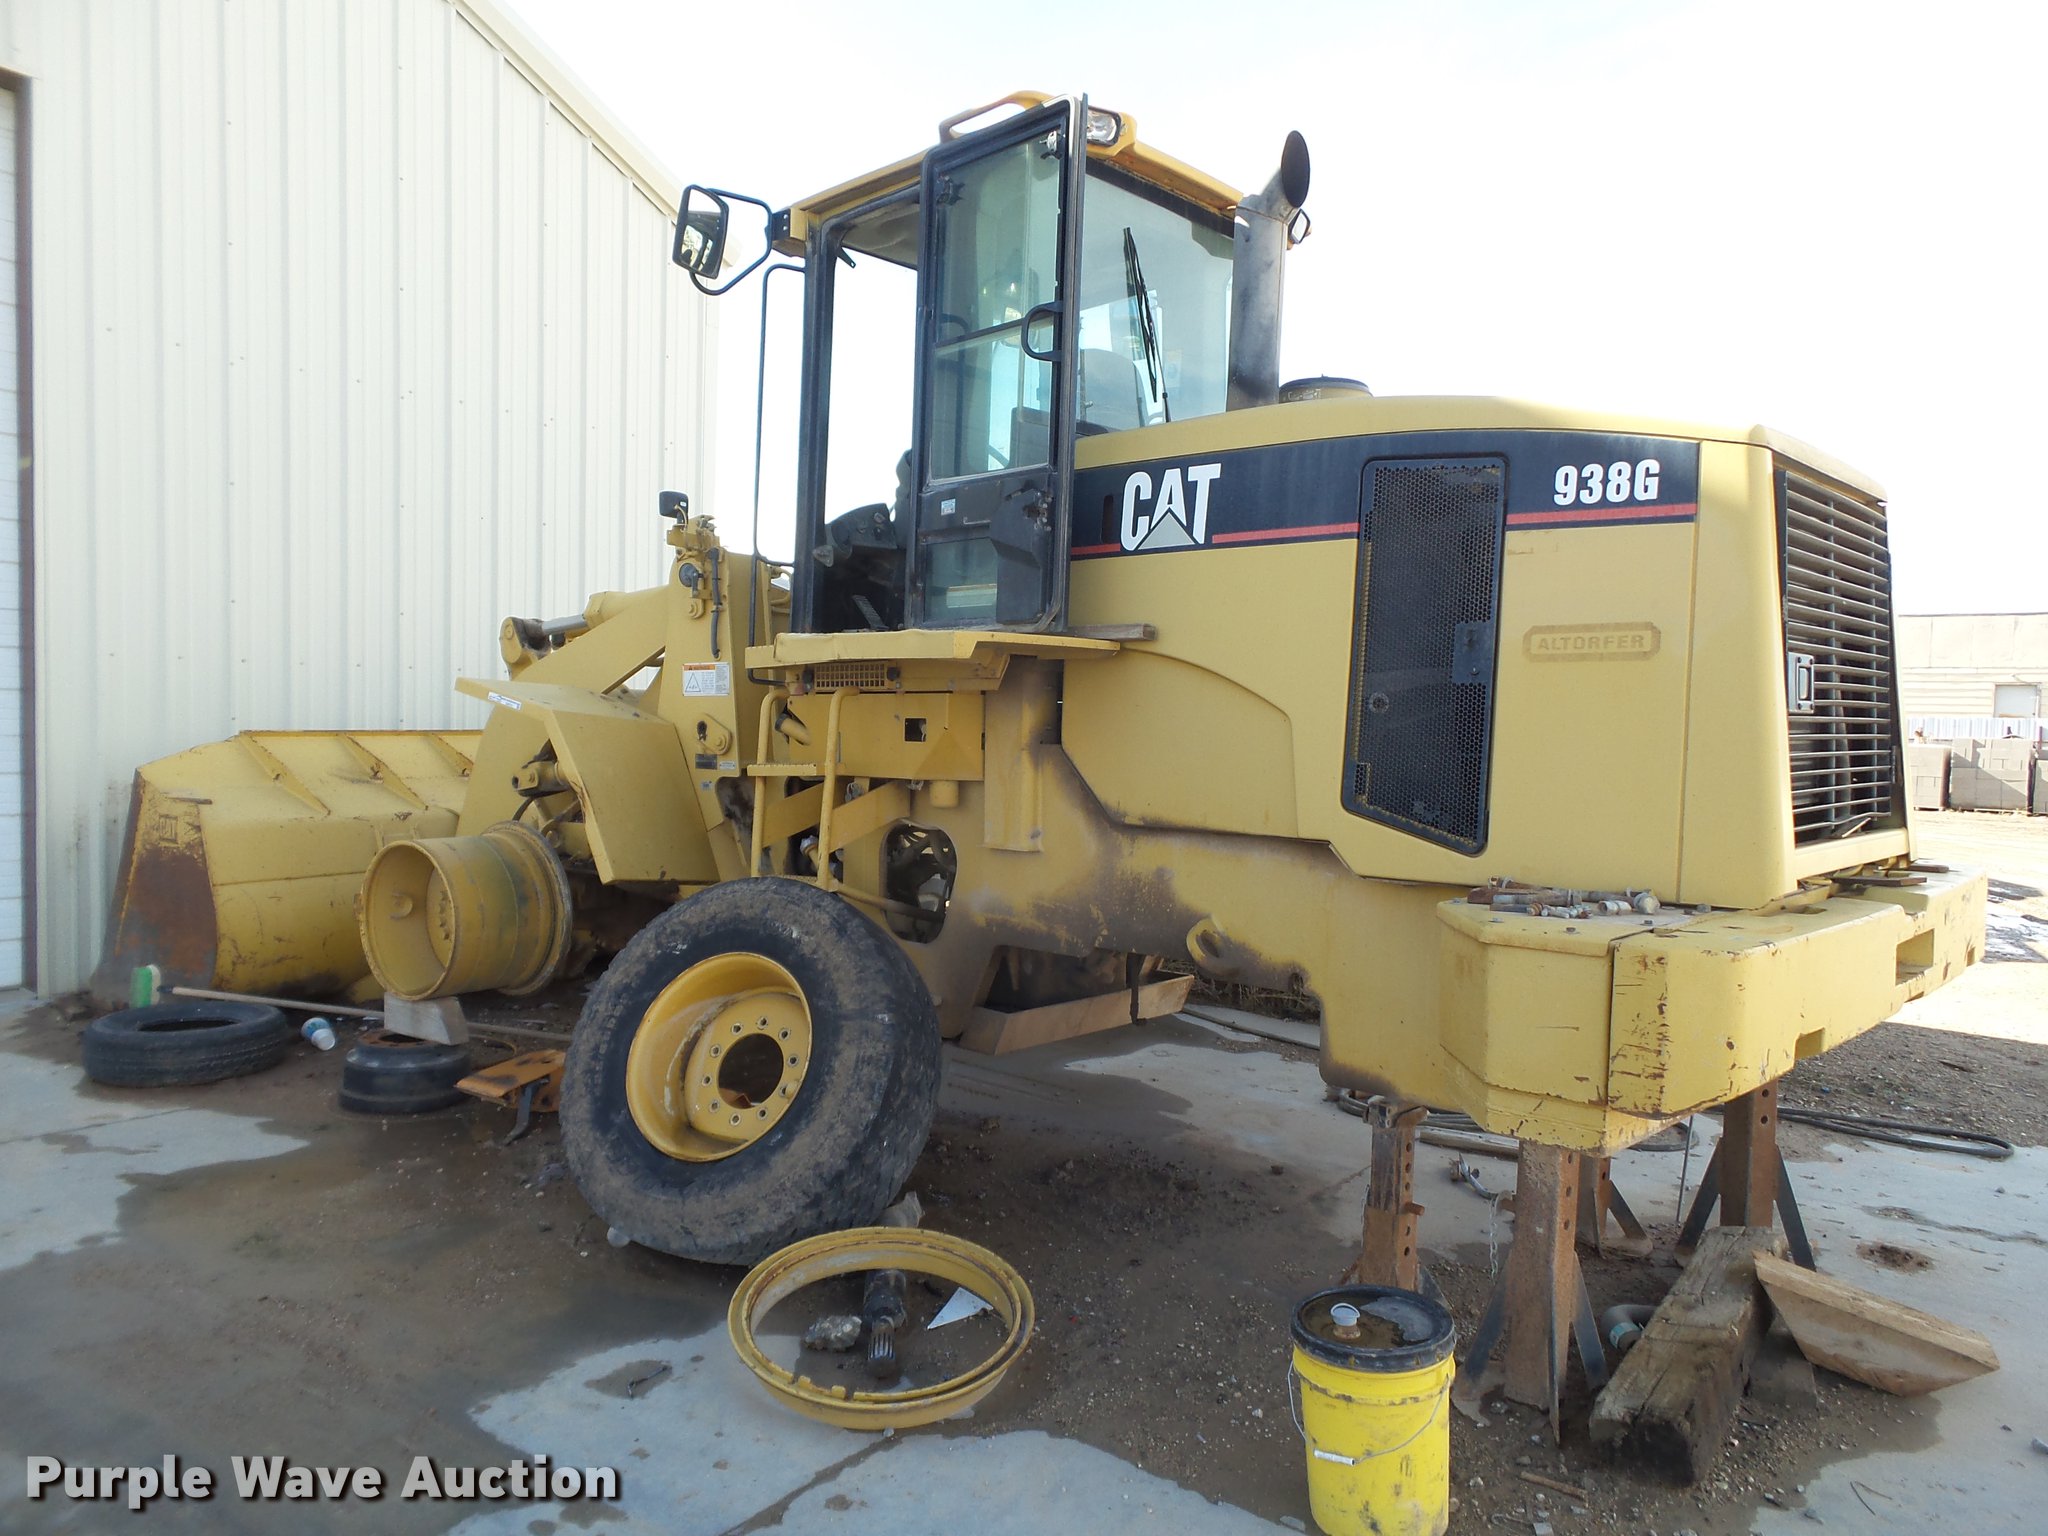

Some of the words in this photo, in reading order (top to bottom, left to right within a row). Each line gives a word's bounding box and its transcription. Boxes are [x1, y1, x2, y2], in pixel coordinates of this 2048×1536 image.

[1554, 459, 1660, 506] 938G
[1121, 463, 1221, 551] CAT
[1538, 635, 1644, 651] ALTORFER
